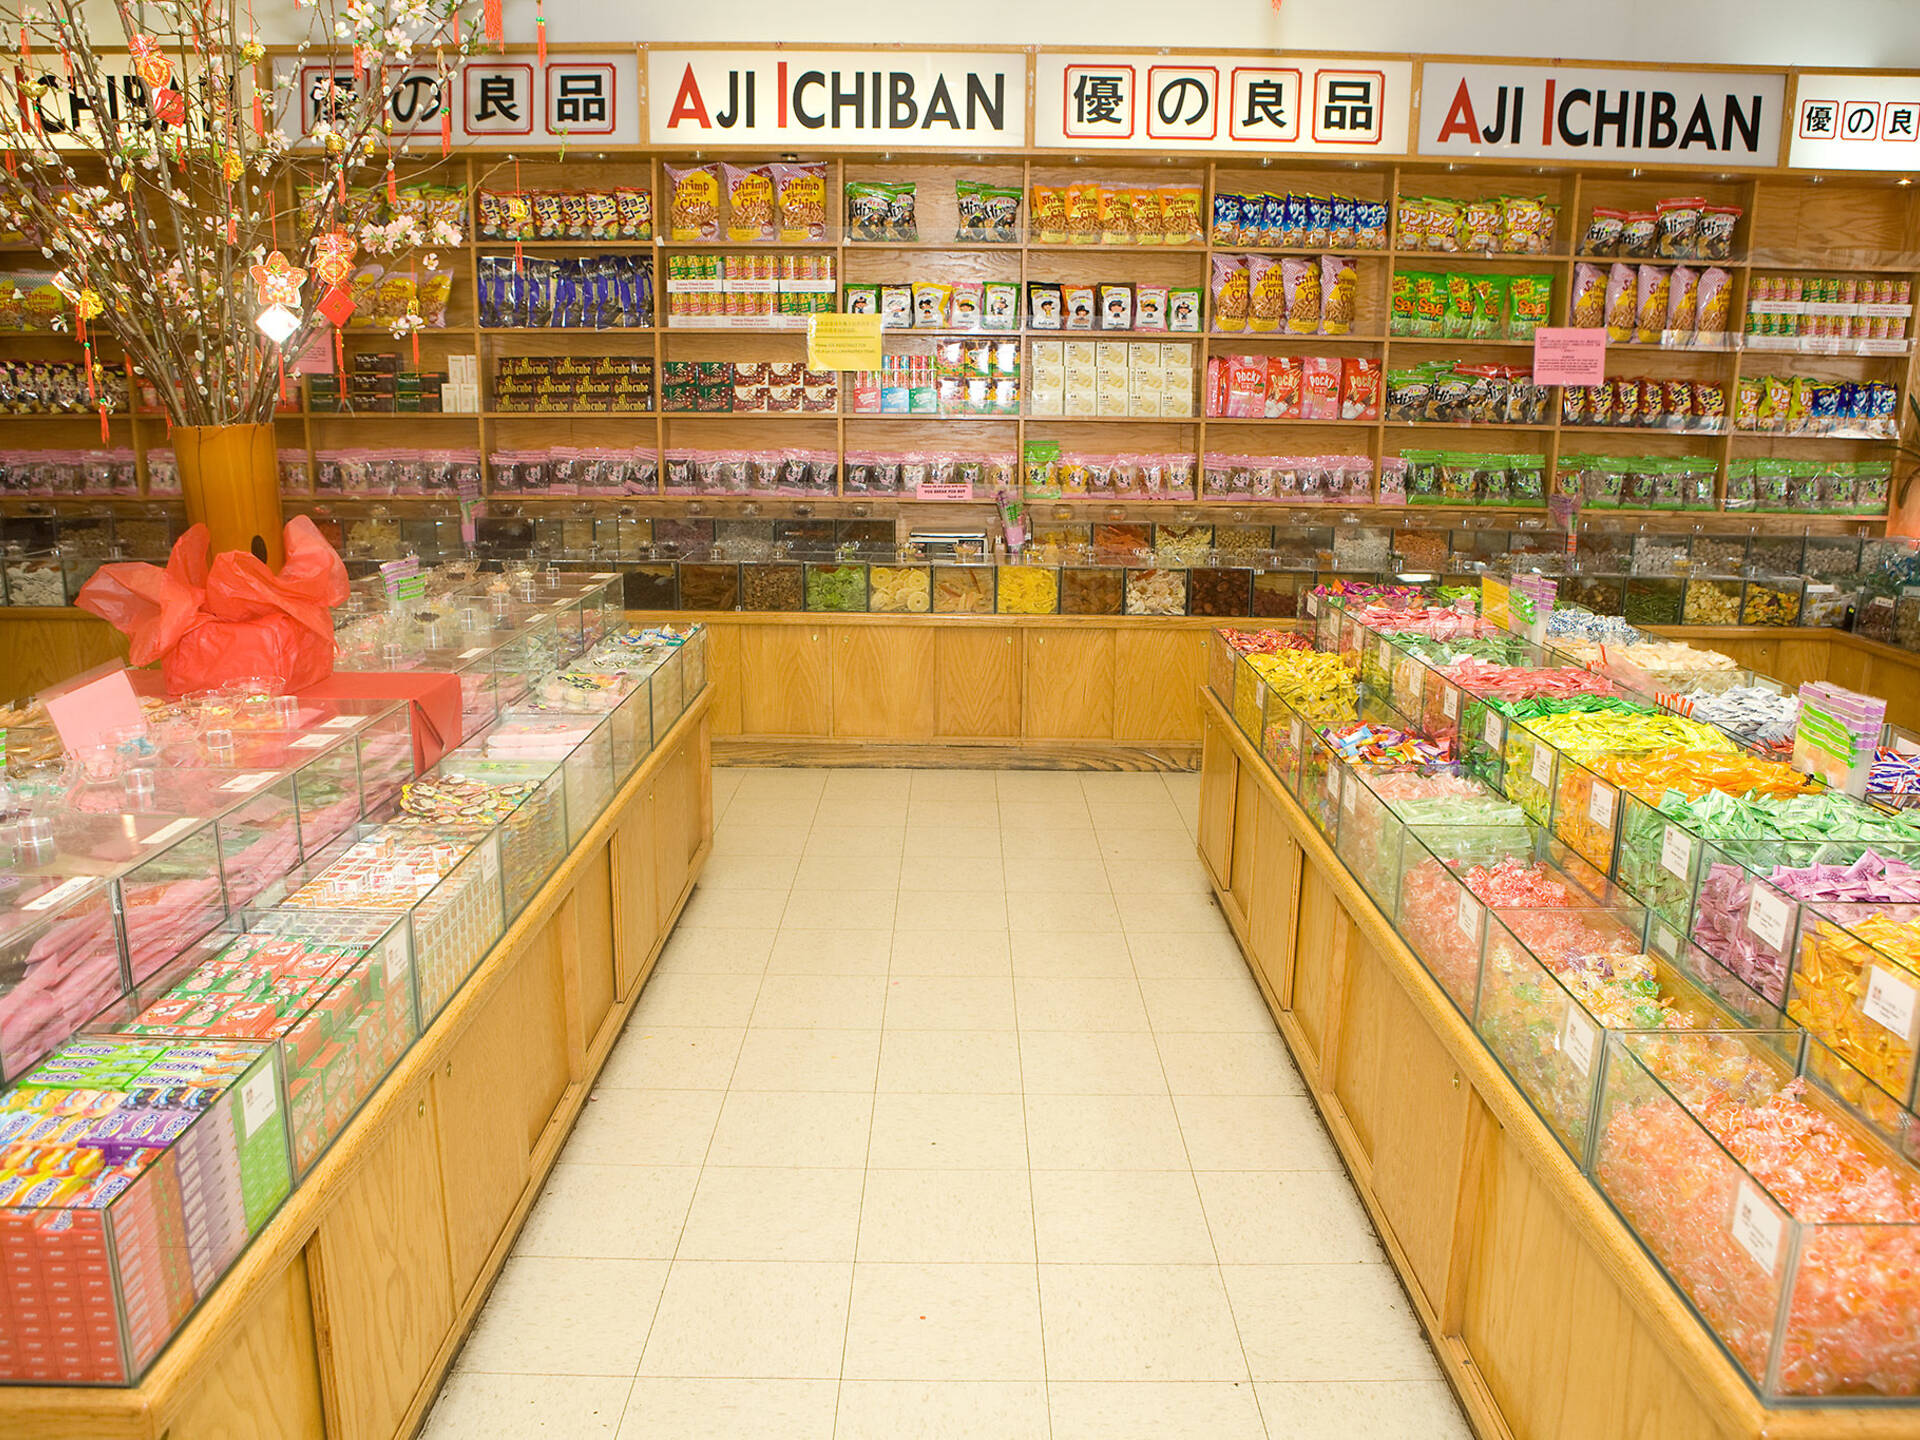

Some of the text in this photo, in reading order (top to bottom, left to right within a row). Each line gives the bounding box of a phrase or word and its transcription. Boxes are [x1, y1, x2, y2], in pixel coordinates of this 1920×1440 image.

[14, 64, 236, 134] ICHIB
[667, 61, 1005, 130] AJI ICHIBAN
[1073, 75, 1373, 131] 優の良品
[1437, 76, 1762, 152] AJI ICHIBAN
[1806, 106, 1911, 134] 優の良
[731, 179, 769, 195] Shrimp
[781, 179, 820, 193] Shrimp
